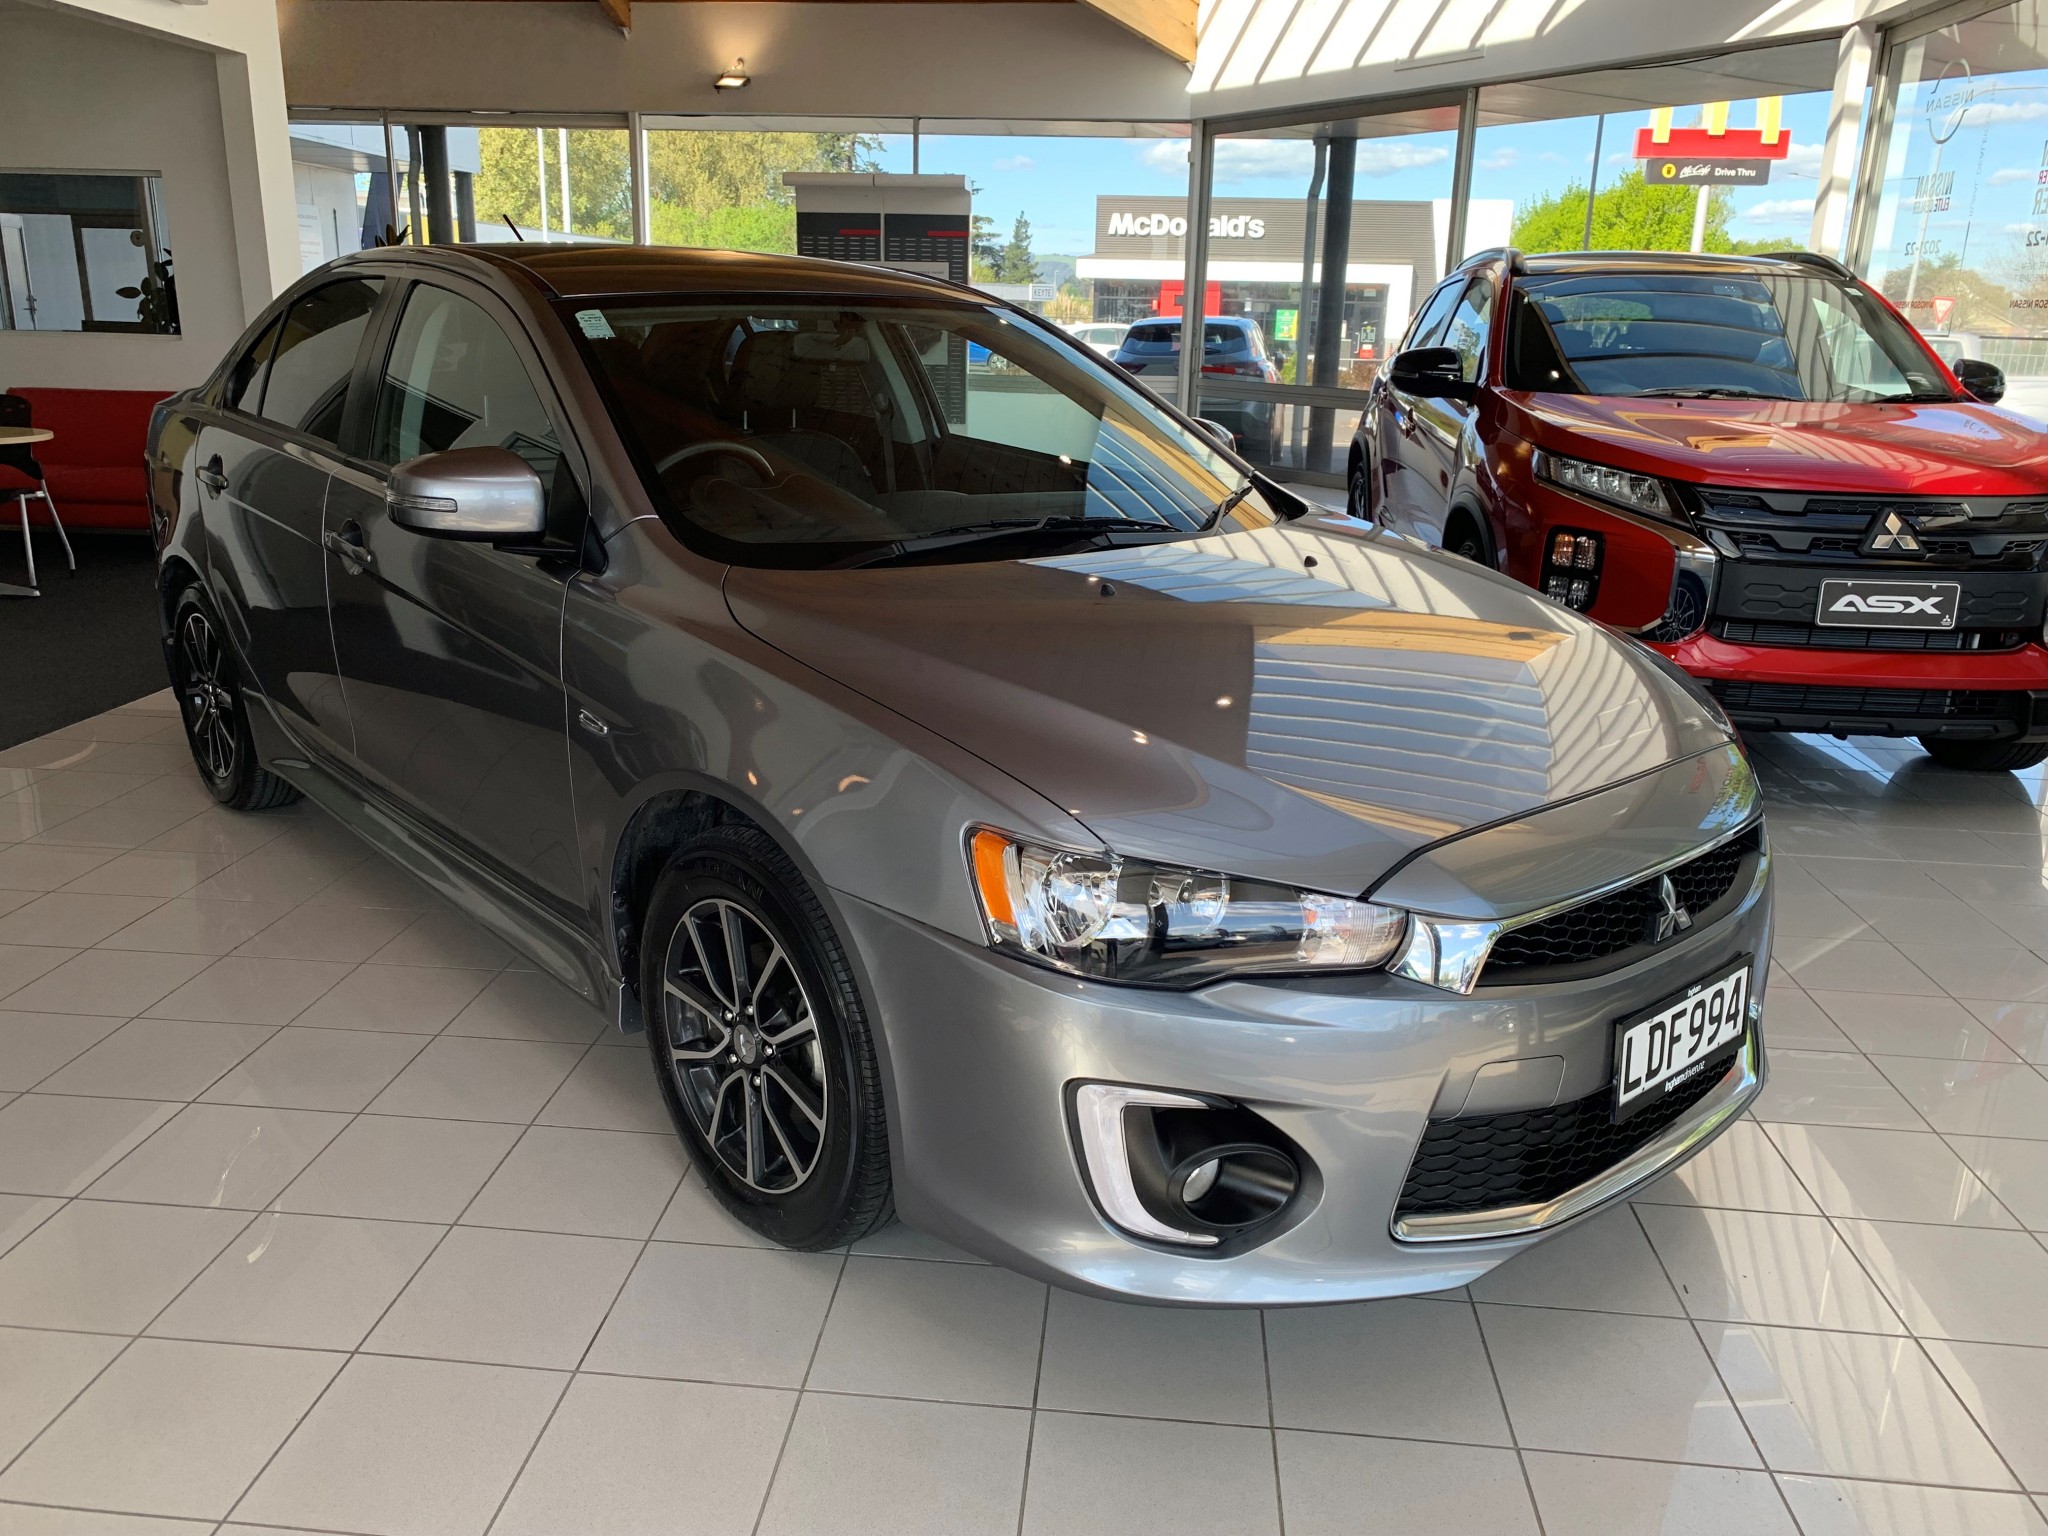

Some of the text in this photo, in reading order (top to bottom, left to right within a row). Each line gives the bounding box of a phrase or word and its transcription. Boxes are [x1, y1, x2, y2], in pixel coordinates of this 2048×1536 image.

[1714, 167, 1736, 176] Drive
[1737, 167, 1756, 177] Thru
[1108, 212, 1265, 238] McDoald's
[1829, 594, 1944, 615] ASX
[1623, 976, 1742, 1095] LDF994
